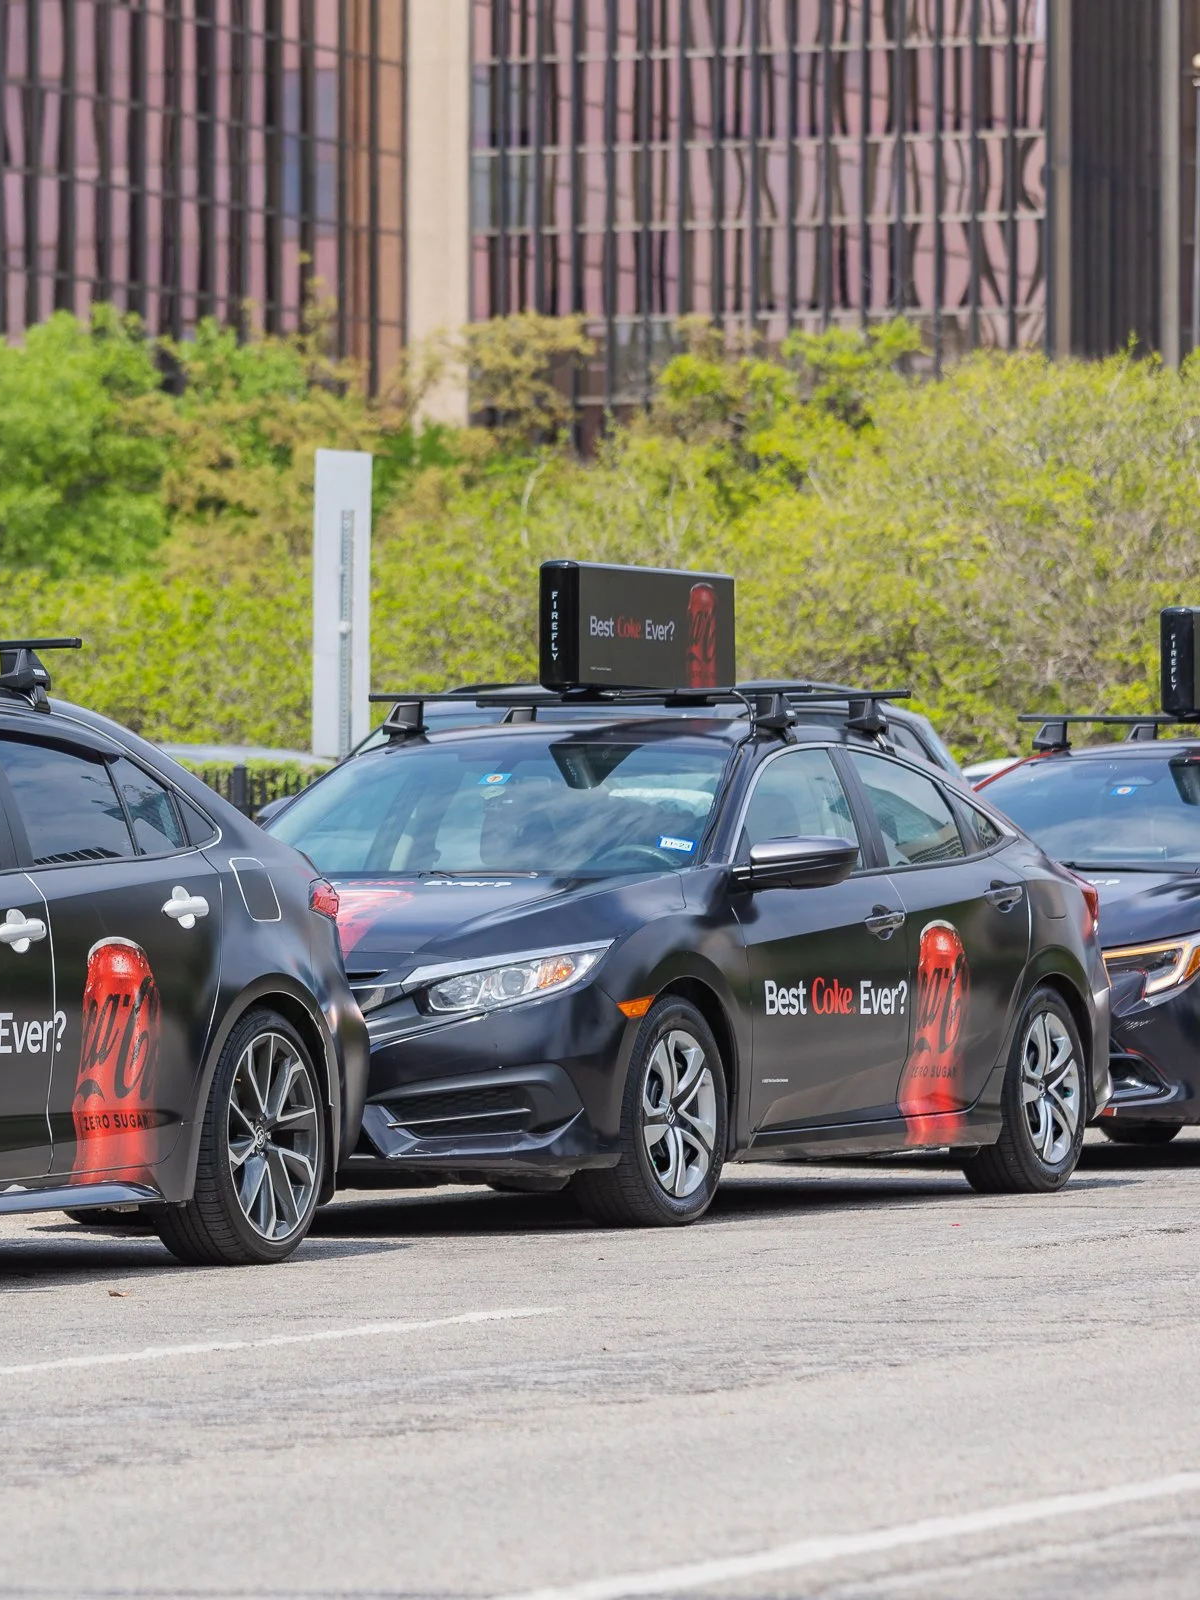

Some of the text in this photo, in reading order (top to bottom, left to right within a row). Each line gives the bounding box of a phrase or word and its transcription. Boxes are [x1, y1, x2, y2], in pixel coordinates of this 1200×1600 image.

[551, 590, 559, 661] FIREFLY
[589, 615, 615, 638] Best
[617, 614, 642, 640] Coke
[645, 619, 675, 642] Ever?
[764, 979, 807, 1016] Best
[859, 979, 908, 1016] Ever?
[83, 1113, 111, 1131] ZERO
